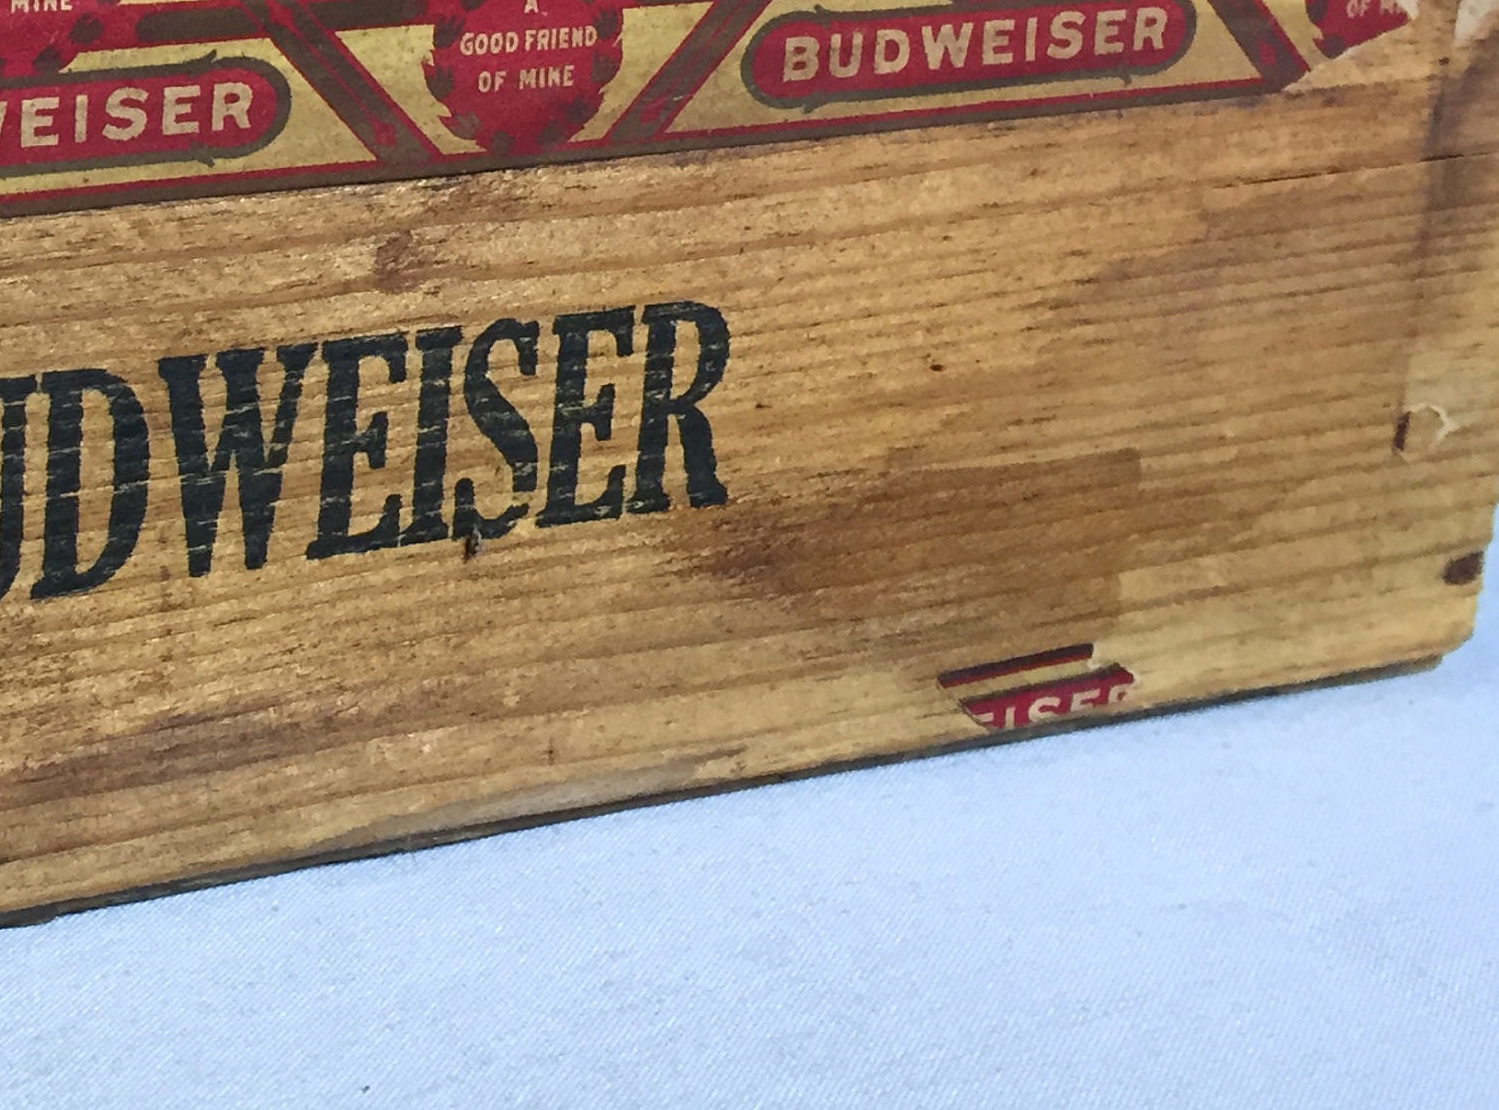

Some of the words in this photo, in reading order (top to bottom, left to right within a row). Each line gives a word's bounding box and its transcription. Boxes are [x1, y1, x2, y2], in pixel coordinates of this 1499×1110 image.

[459, 29, 519, 56] GOOD
[524, 24, 598, 53] FRIEND
[782, 6, 1168, 83] BUDWEISER
[478, 70, 506, 93] OF
[519, 65, 575, 90] MINE
